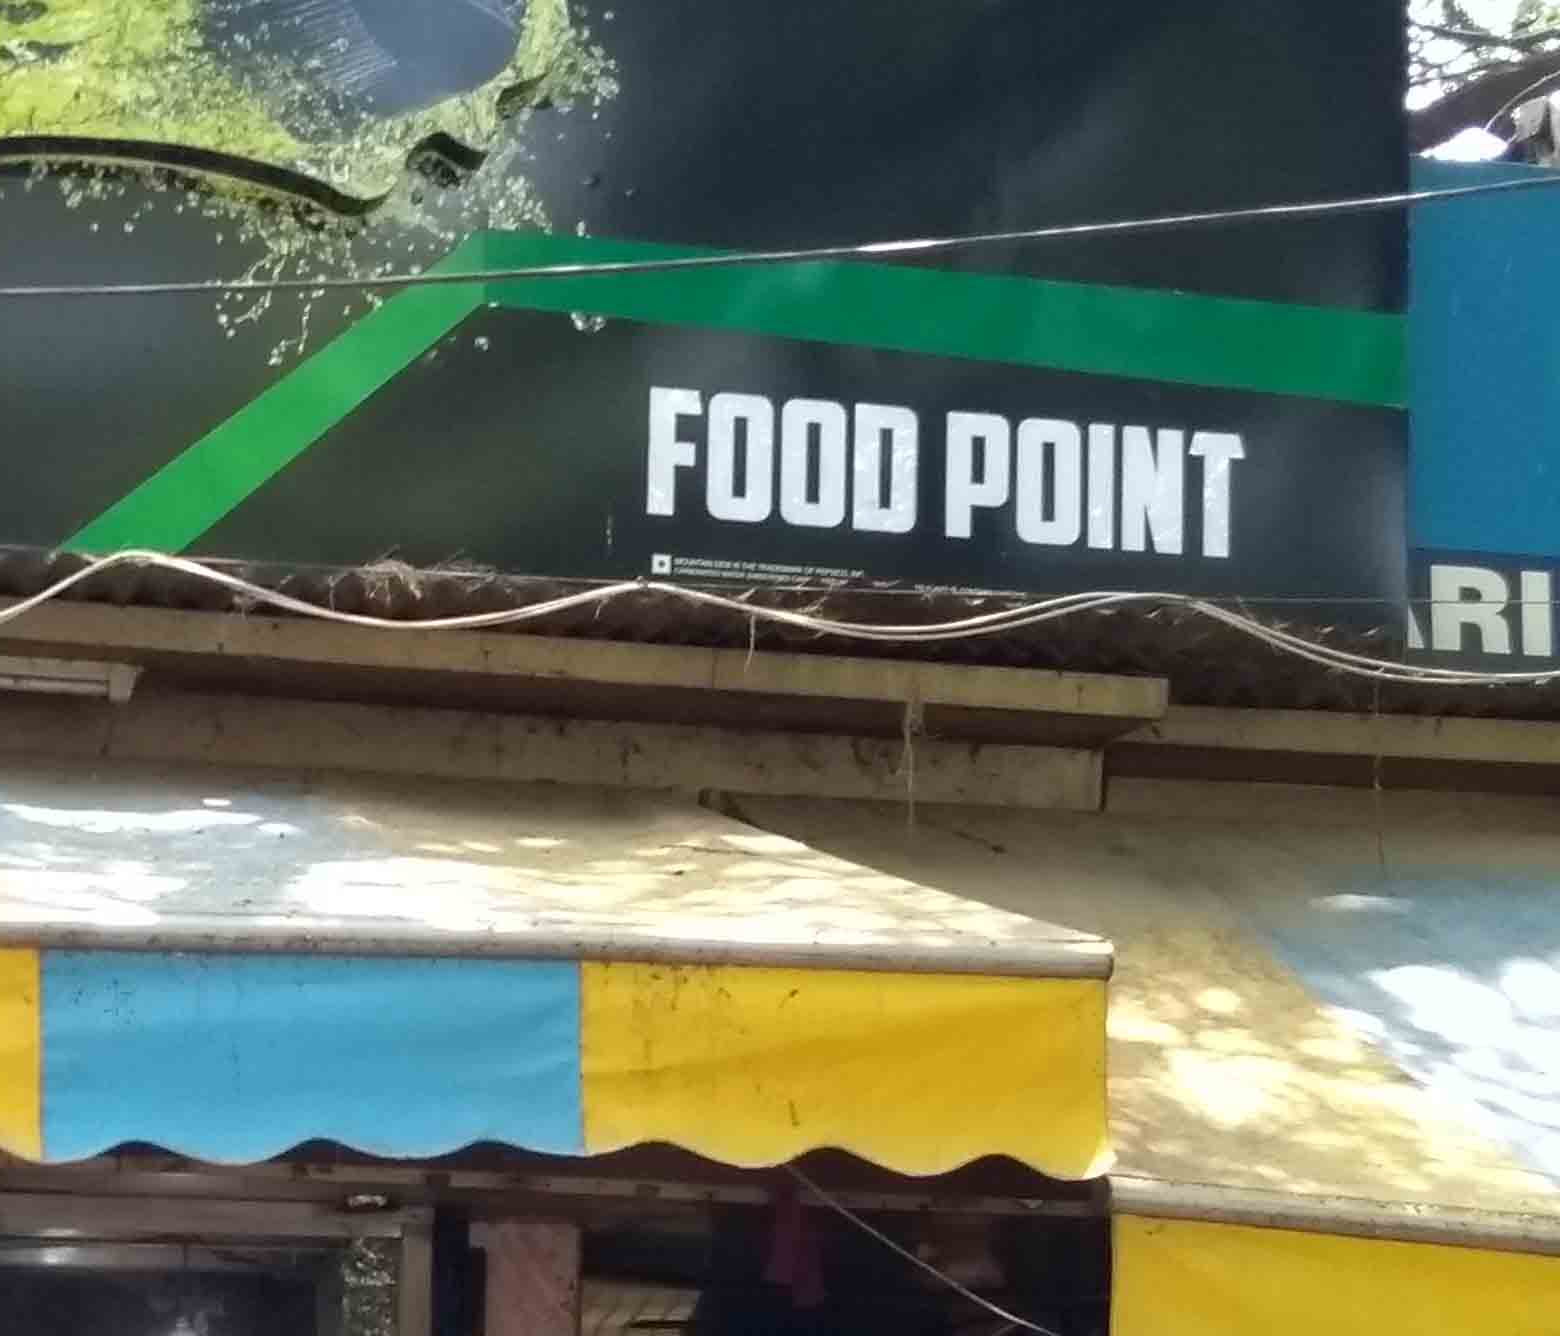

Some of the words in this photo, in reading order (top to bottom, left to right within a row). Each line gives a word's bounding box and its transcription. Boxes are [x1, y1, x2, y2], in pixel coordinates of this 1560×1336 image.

[646, 386, 918, 533] FOOD
[945, 411, 1245, 558] POINT
[1407, 564, 1551, 656] RI
